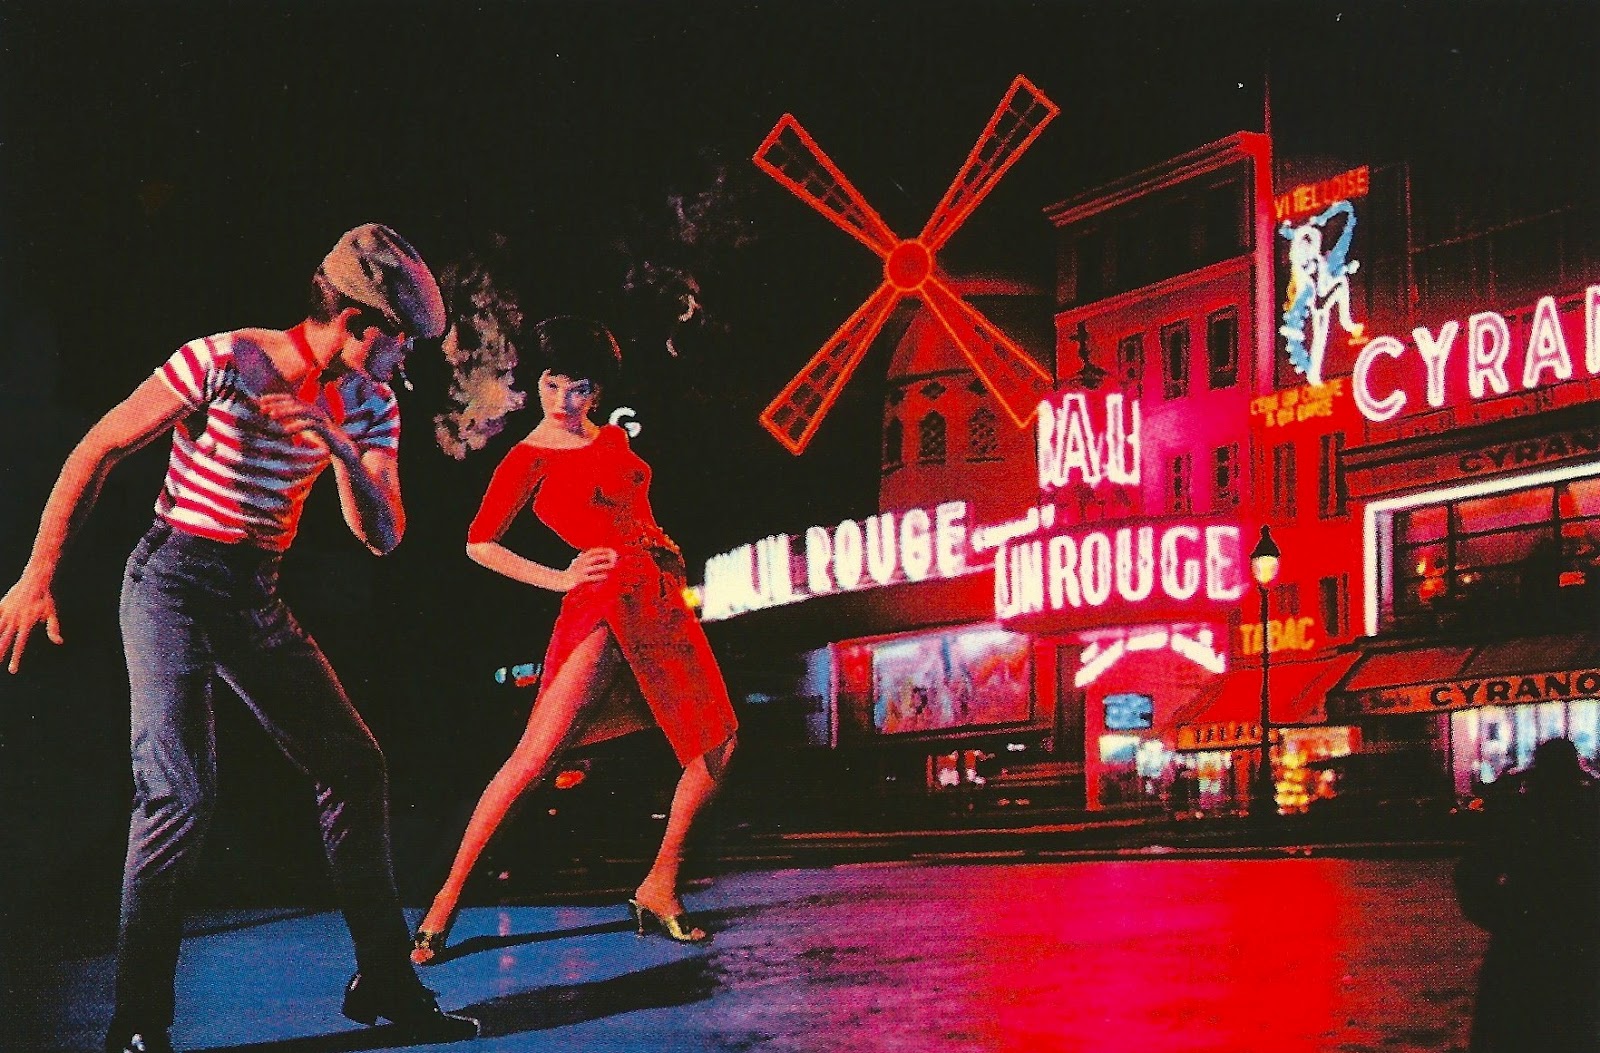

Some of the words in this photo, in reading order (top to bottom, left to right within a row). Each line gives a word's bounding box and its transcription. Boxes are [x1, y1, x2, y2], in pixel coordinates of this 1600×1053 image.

[805, 500, 967, 594] ROUGE
[1048, 524, 1243, 610] ROUGE
[1430, 670, 1600, 707] CYRANO
